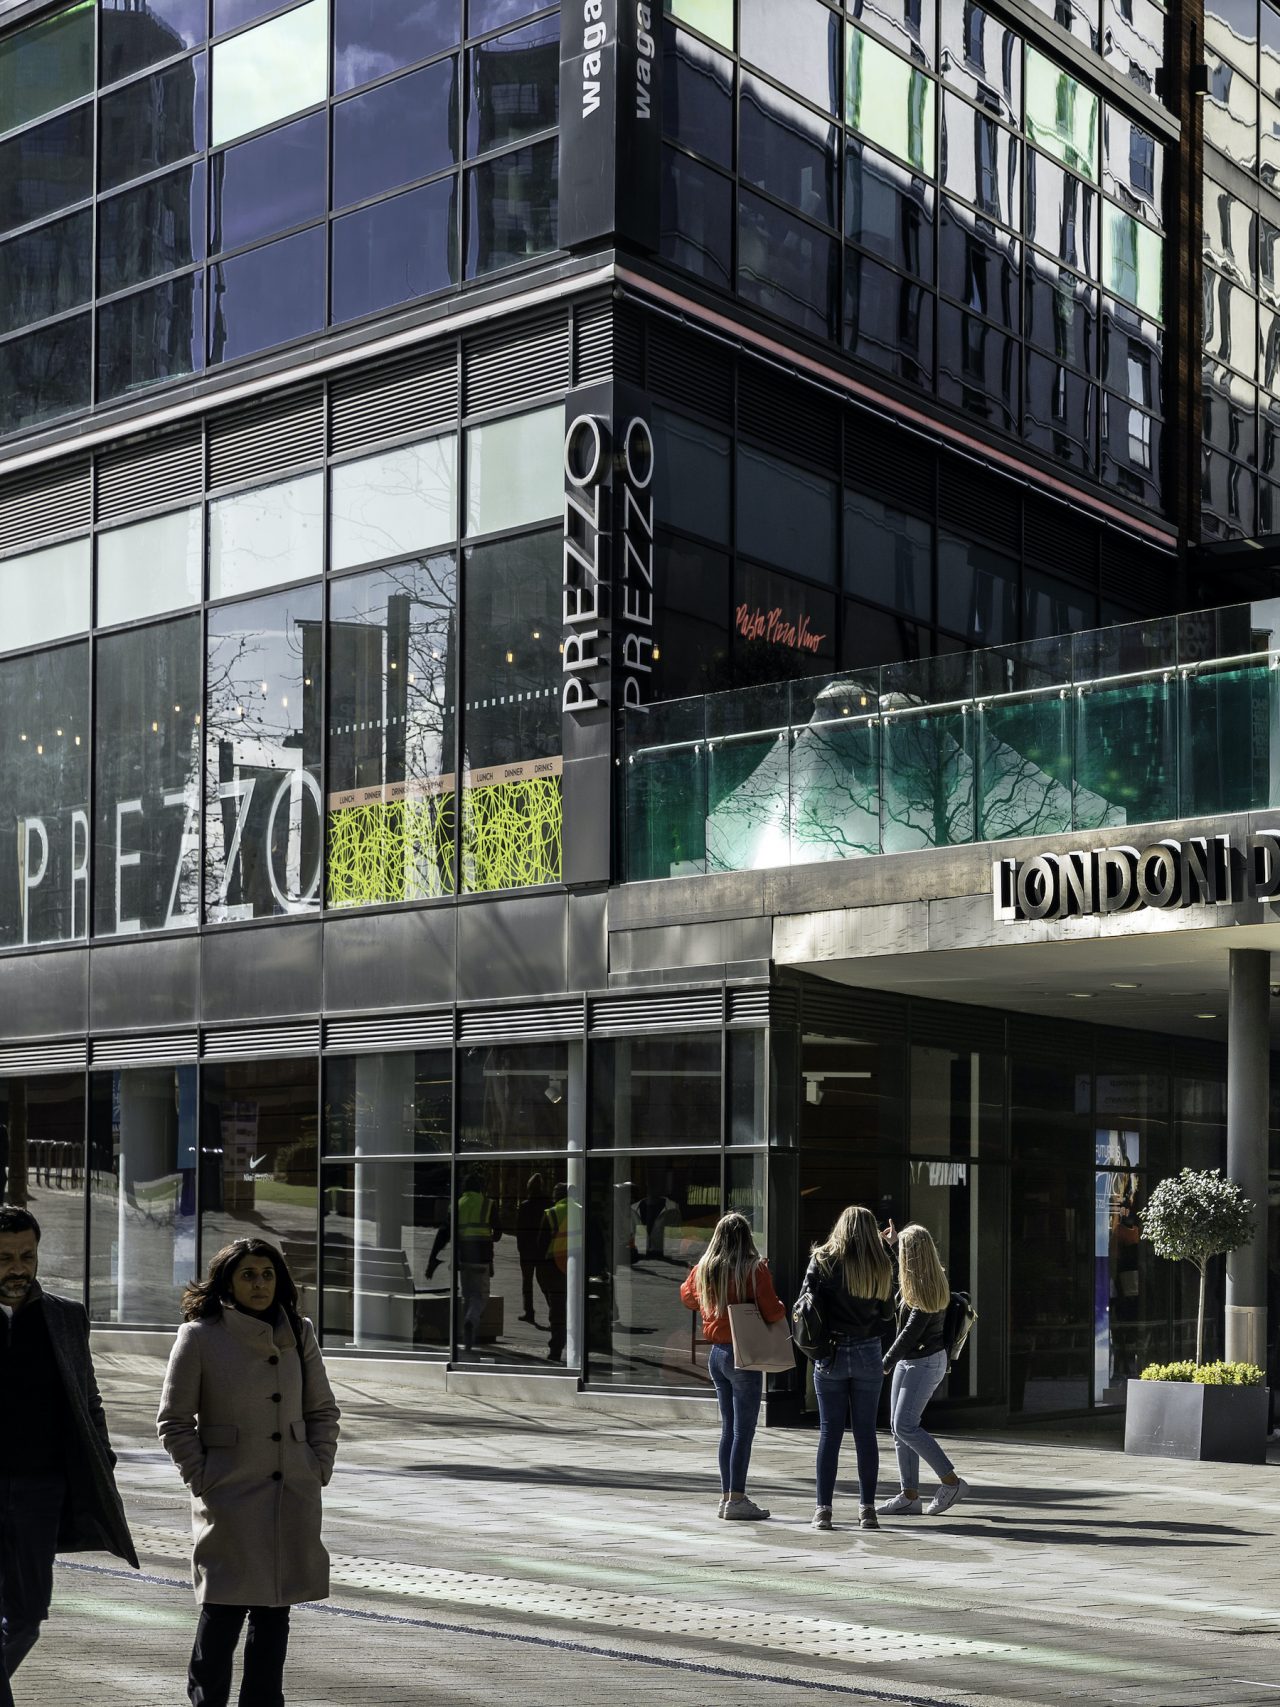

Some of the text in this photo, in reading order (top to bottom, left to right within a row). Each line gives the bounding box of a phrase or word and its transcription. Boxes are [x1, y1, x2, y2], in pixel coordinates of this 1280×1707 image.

[563, 414, 600, 712] PREZZO
[624, 416, 654, 713] PREZZO
[736, 603, 826, 653] Pasta Pizza Vino
[339, 795, 355, 804] LUNCH
[364, 791, 382, 800] DINNER
[476, 763, 553, 782] LUNCH DINNER DRINKS
[993, 833, 1232, 923] LONDON
